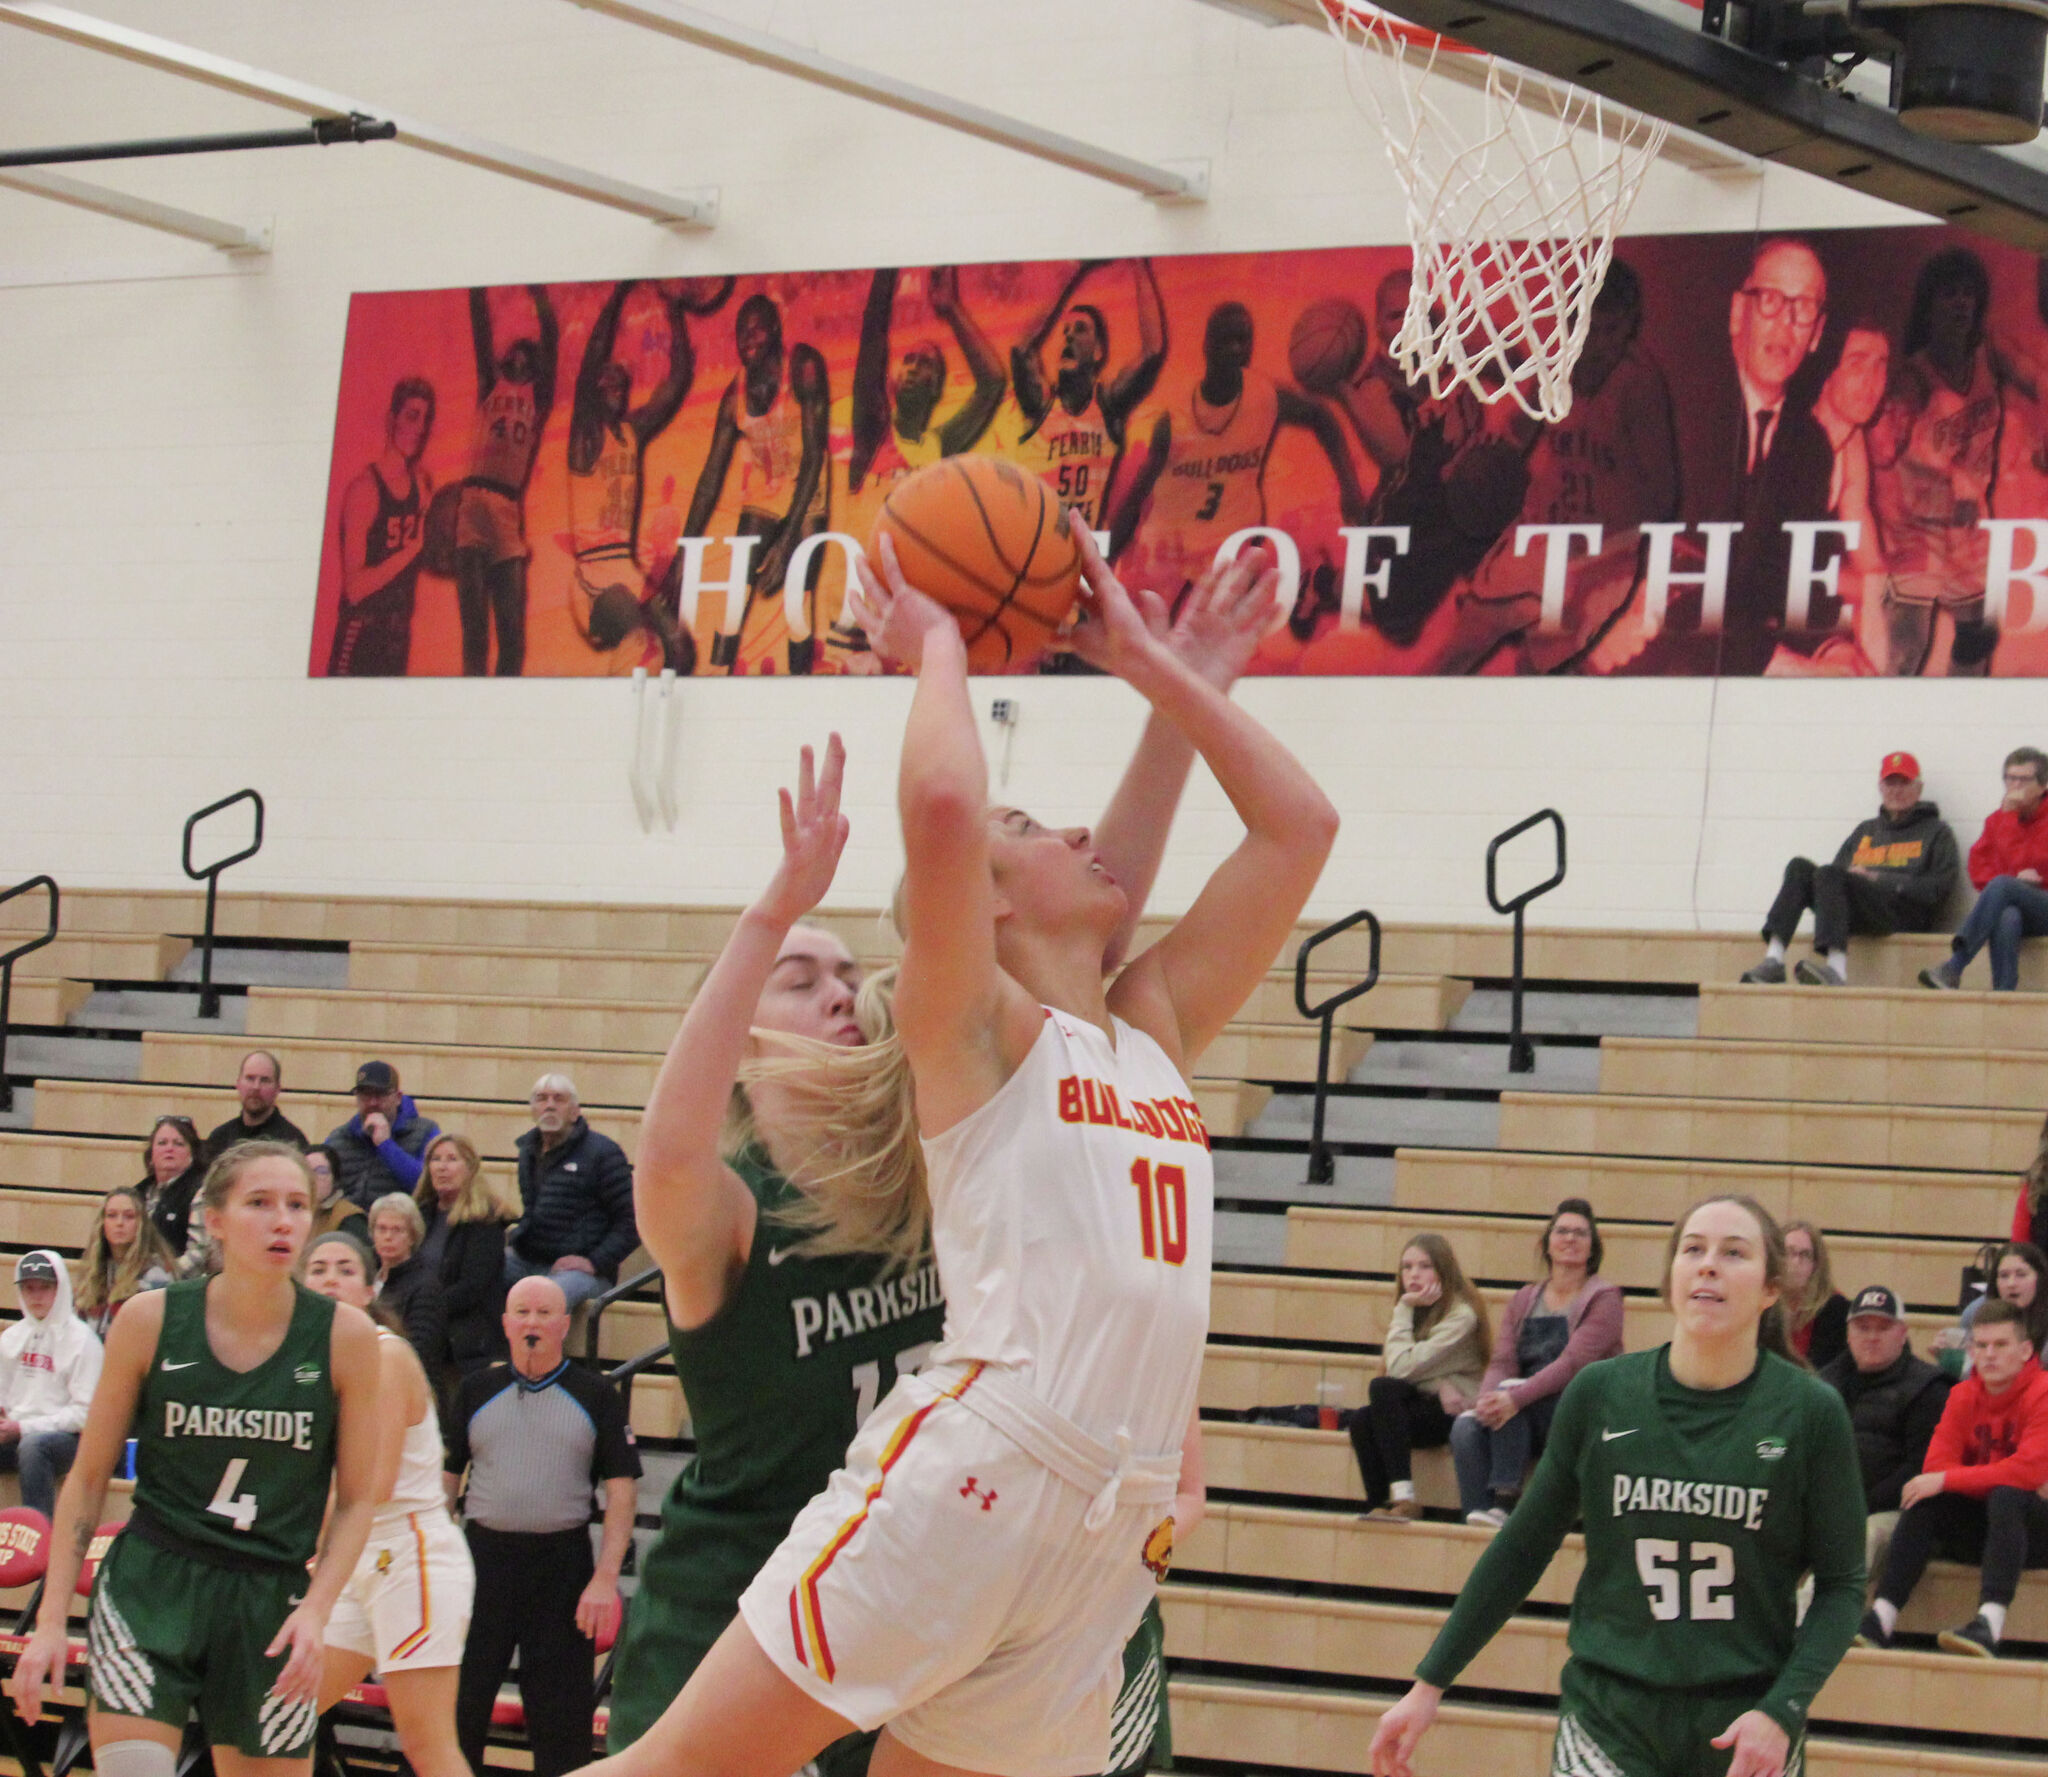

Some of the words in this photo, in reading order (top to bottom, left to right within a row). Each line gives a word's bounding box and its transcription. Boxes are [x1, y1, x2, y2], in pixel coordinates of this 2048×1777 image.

[1057, 465, 1089, 497] 50
[1195, 483, 1224, 520] 3
[1213, 526, 1410, 635] OF
[1514, 520, 1861, 634] THE
[1130, 1156, 1187, 1267] 10
[164, 1401, 314, 1451] PARKSIDE
[206, 1458, 258, 1531] 4
[1613, 1474, 1769, 1531] PARKSIDE
[1635, 1538, 1735, 1620] 52
